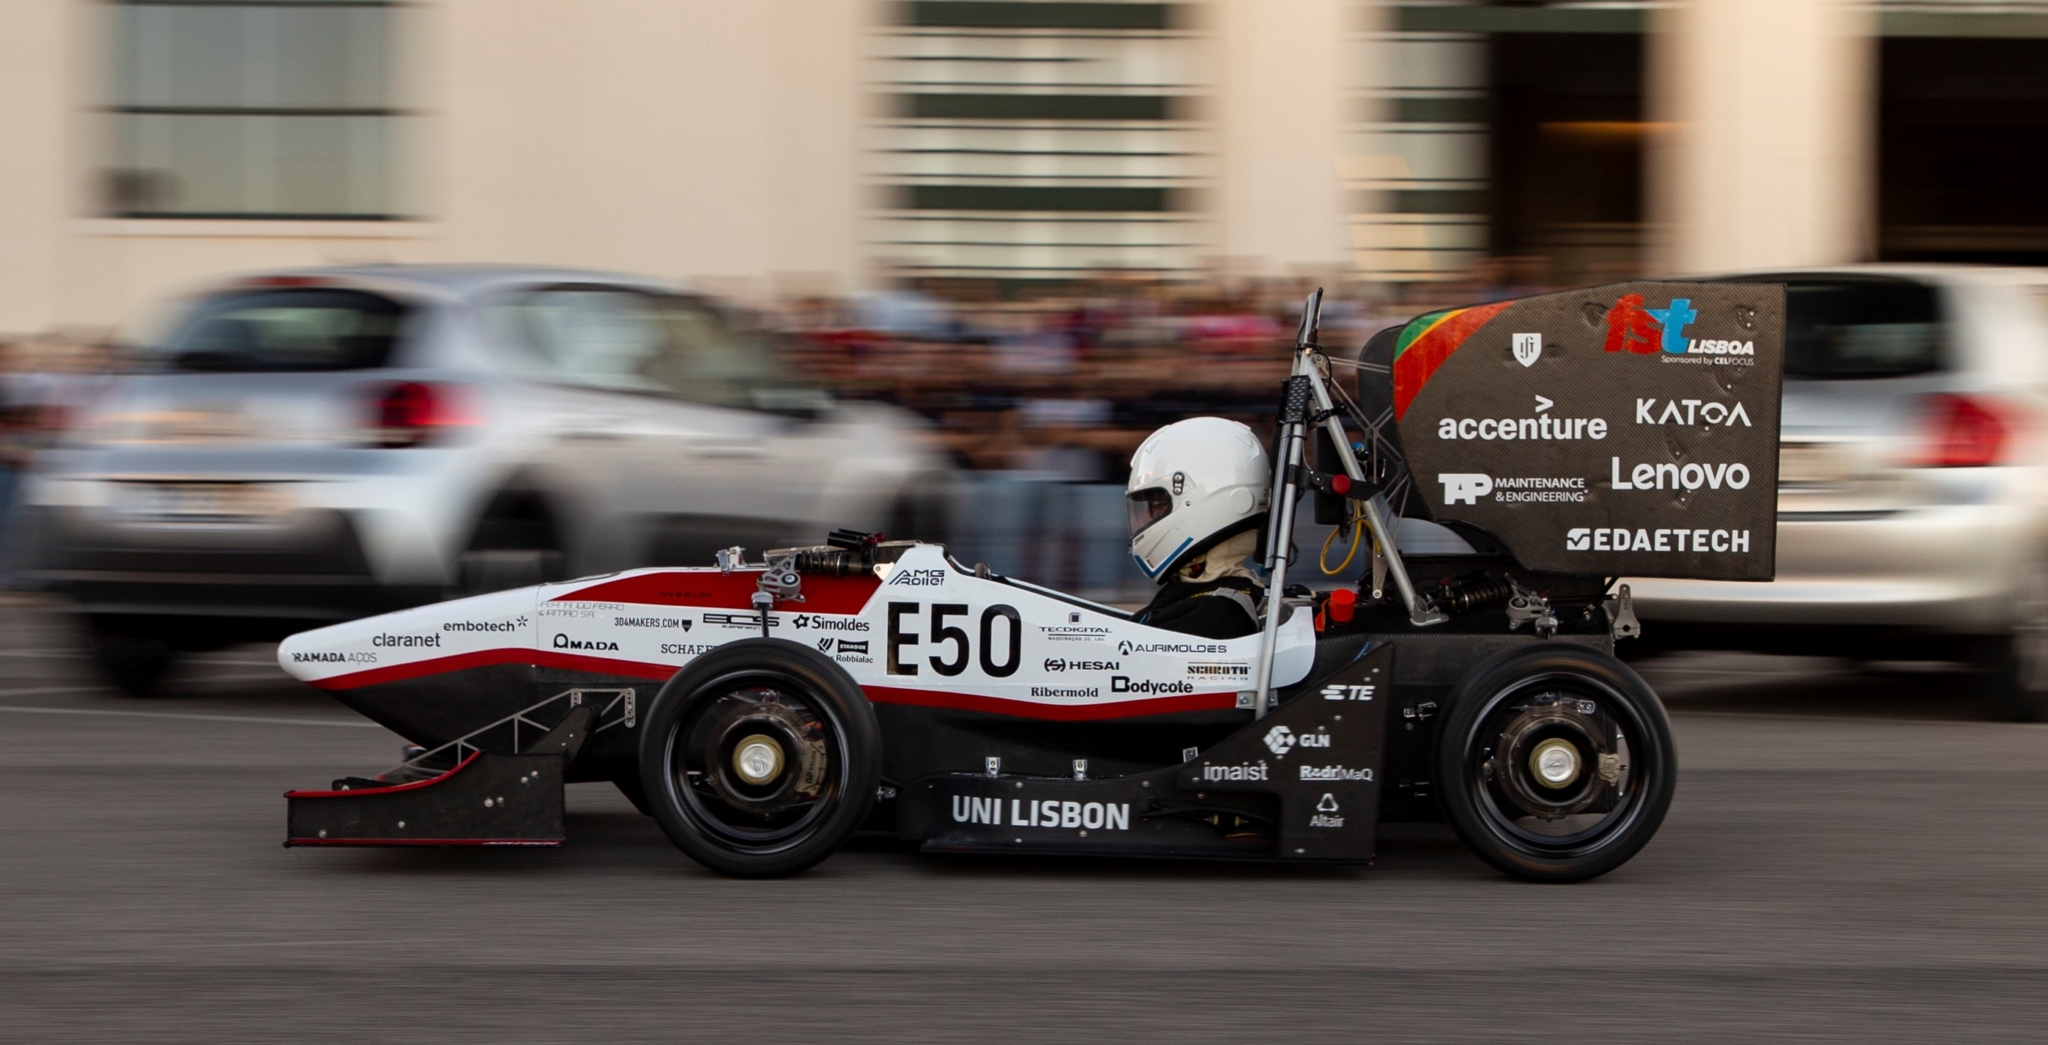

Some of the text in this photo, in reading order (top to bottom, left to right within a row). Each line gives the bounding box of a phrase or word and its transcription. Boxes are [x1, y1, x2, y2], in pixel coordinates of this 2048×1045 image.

[1687, 339, 1755, 356] LISBOA
[1661, 355, 1702, 366] Sponsored
[1703, 356, 1714, 367] by
[1438, 413, 1608, 440] accenture
[1611, 456, 1750, 490] Lenovo
[1438, 473, 1493, 505] TAP
[1494, 477, 1585, 489] MAINTENANCE
[1495, 491, 1584, 503] & ENGINEERING
[1593, 528, 1750, 553] EDAETECH
[443, 620, 515, 632] embotech
[614, 617, 680, 629] 3D4MAKERS.COM
[811, 615, 870, 632] Simoldes
[1038, 626, 1113, 634] TECDIGITAL
[372, 632, 441, 648] claranet
[886, 601, 1022, 678] E50
[660, 643, 712, 655] SCHAEF
[1134, 643, 1228, 654] AURIMOLDES
[291, 651, 378, 665] RAMADA AÇOS
[836, 654, 874, 664] Robbialac
[1069, 661, 1120, 671] HESAI
[1187, 665, 1249, 675] SCHROTH
[1030, 686, 1099, 698] Ribermold
[1111, 675, 1194, 696] Bodycote
[1348, 685, 1376, 701] TE
[1299, 733, 1331, 748] GLN
[1203, 761, 1269, 781] imaist
[952, 795, 1130, 831] UNI LISBON
[1308, 813, 1345, 828] Altair
